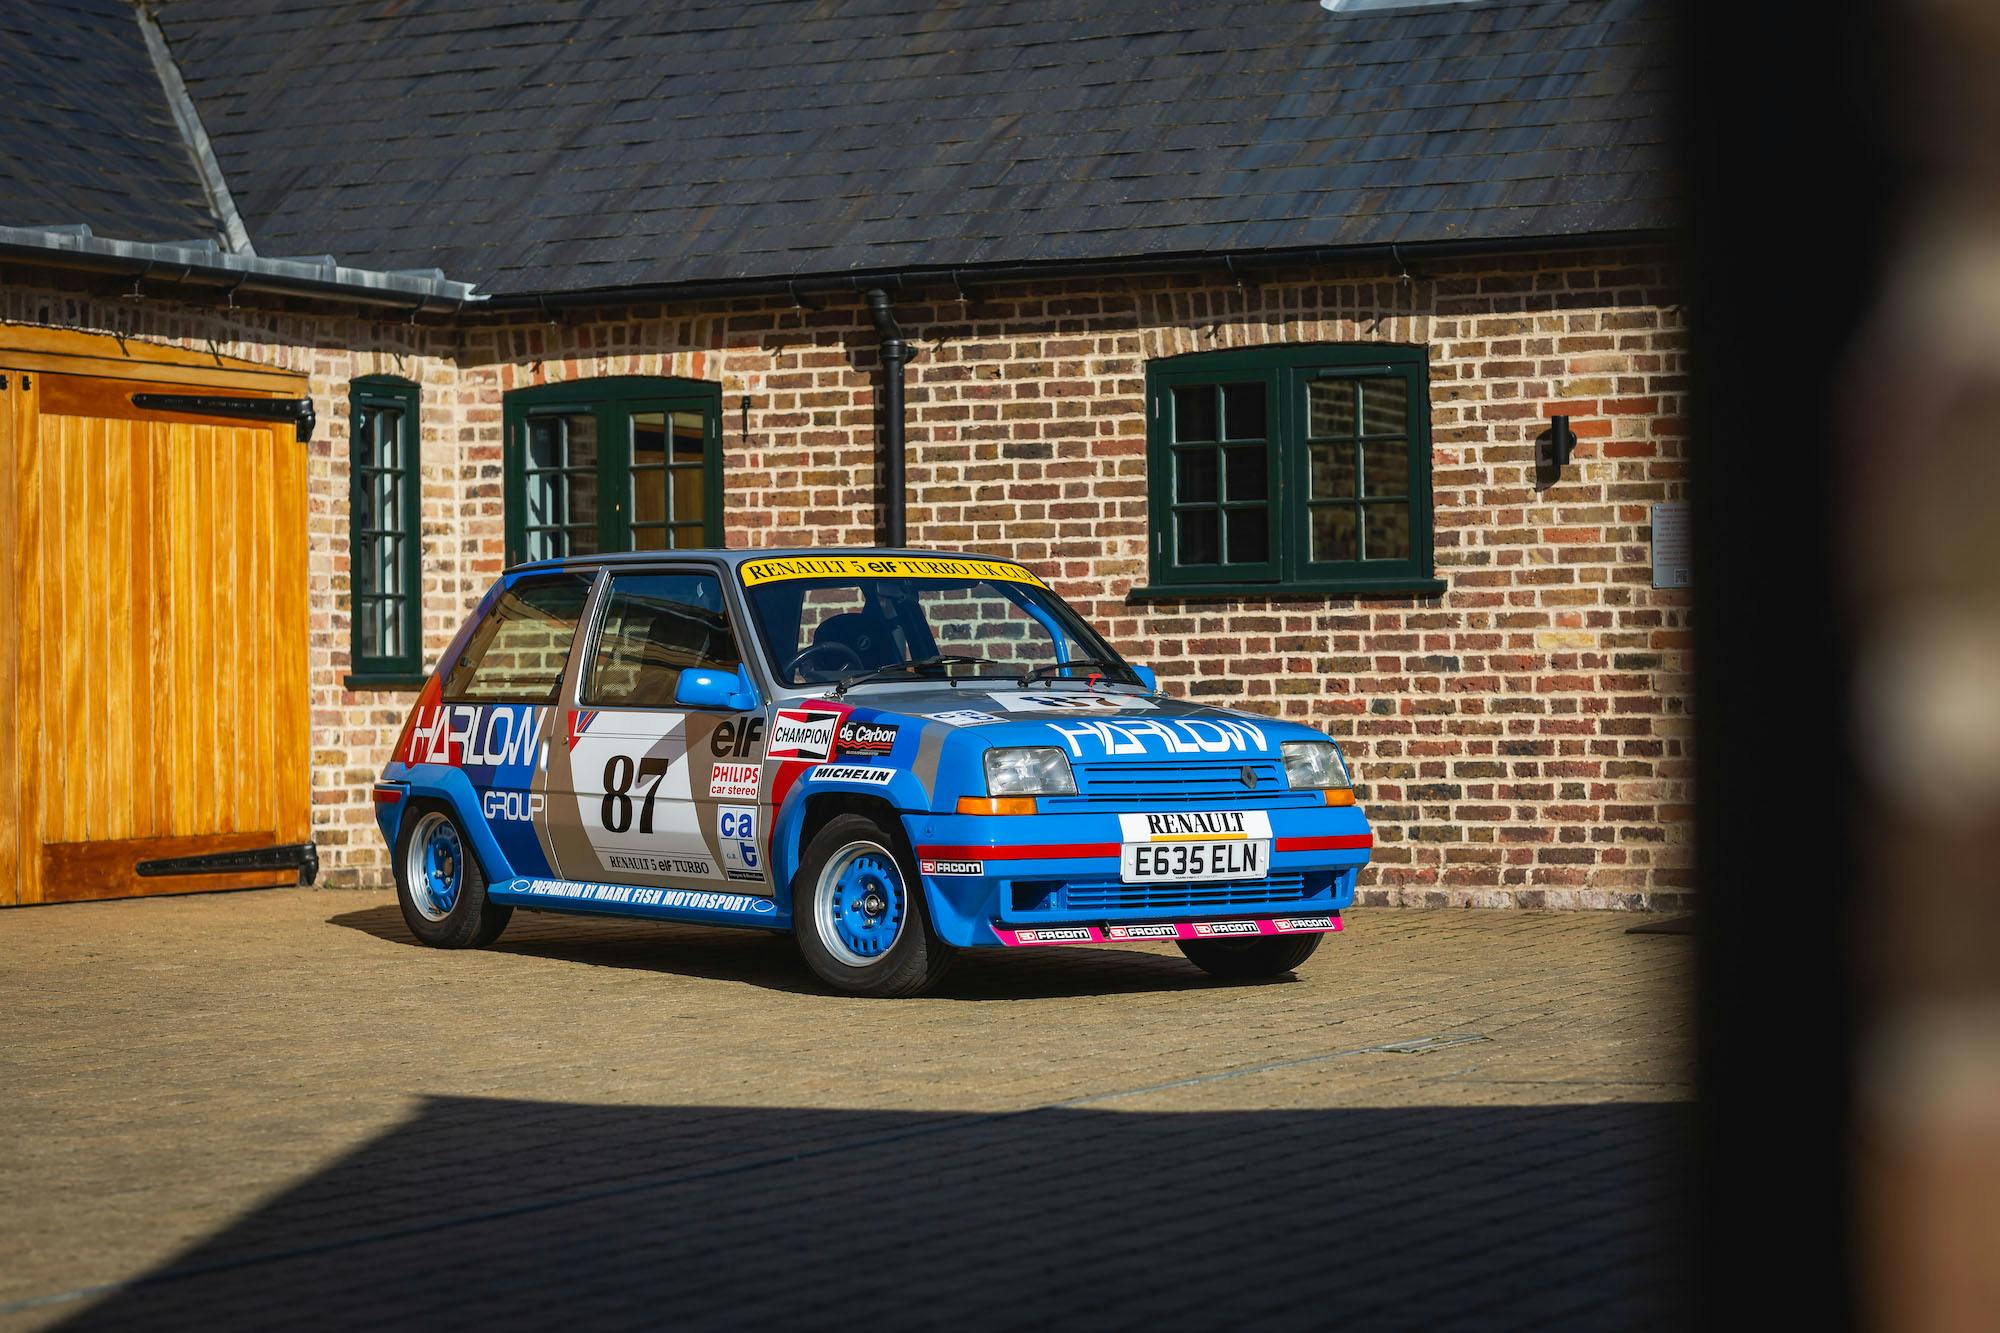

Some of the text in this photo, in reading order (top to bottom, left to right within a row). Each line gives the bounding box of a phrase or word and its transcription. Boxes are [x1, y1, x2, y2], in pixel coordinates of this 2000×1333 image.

[749, 560, 1035, 582] RENAULT 5 elf TURBO UK CUP
[409, 705, 549, 767] HARLOW
[710, 716, 765, 758] elf
[775, 726, 831, 745] CHAMPION
[839, 722, 897, 743] de Carbon
[1046, 719, 1268, 757] HARLOW
[712, 765, 759, 784] PHILIPS
[814, 767, 891, 782] MICHELIN
[601, 754, 669, 834] 87
[711, 785, 756, 796] car stereo
[484, 790, 545, 821] GROUP
[1145, 812, 1244, 834] RENAULT
[609, 855, 710, 874] RENAULT 5 elf TURBO
[1135, 843, 1257, 876] E635 ELN
[529, 880, 753, 912] PREPARATION BY MARK FISH MOTORSPORT
